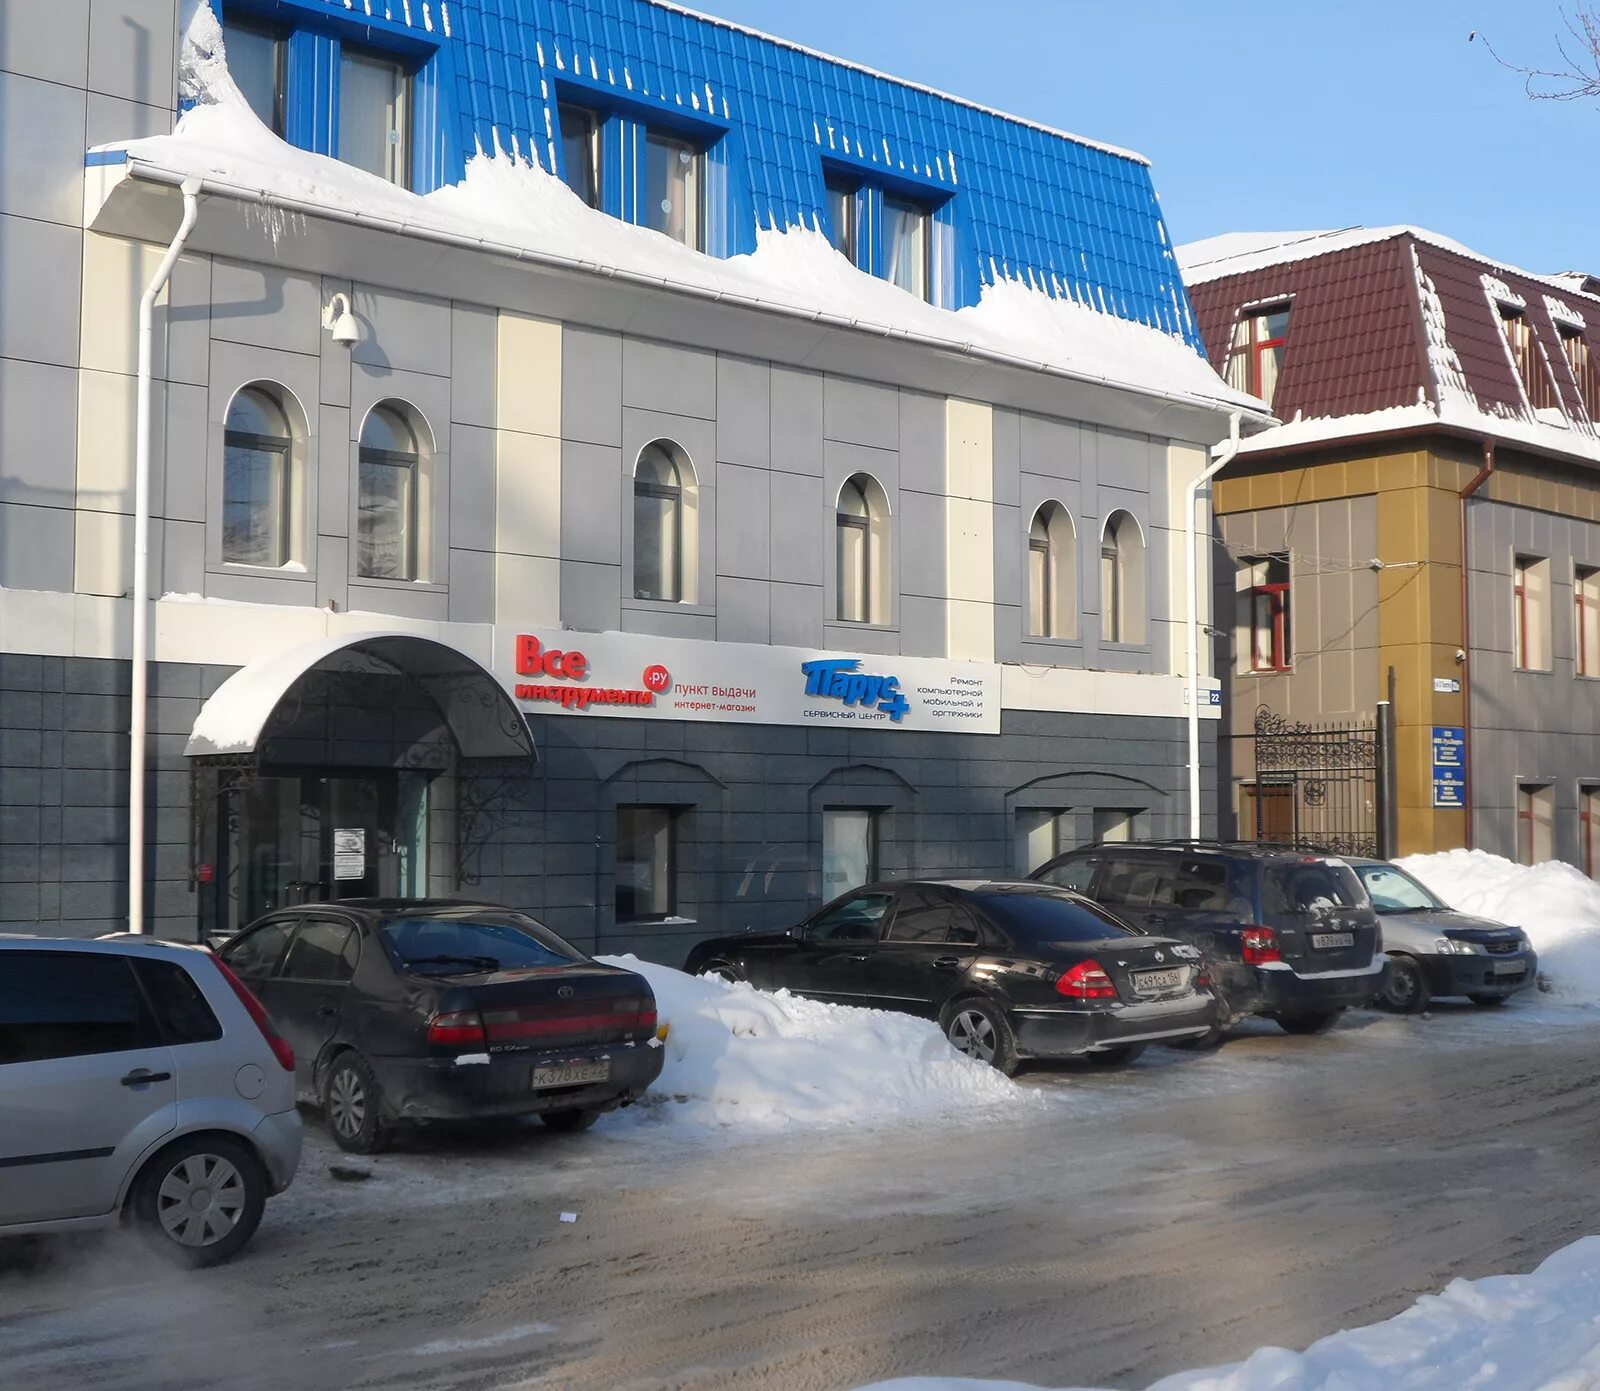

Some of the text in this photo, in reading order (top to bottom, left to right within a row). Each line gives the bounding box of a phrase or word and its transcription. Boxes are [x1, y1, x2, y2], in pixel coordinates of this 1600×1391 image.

[515, 634, 587, 679] Все
[950, 676, 983, 687] Ремонт
[515, 683, 653, 708] инструменты
[674, 684, 757, 699] пункт выдачи
[917, 687, 983, 697] компьютерной
[922, 697, 974, 708] мобильной
[1211, 693, 1220, 702] 22
[674, 700, 756, 713] интернет-магазин
[932, 709, 983, 719] оргтехники
